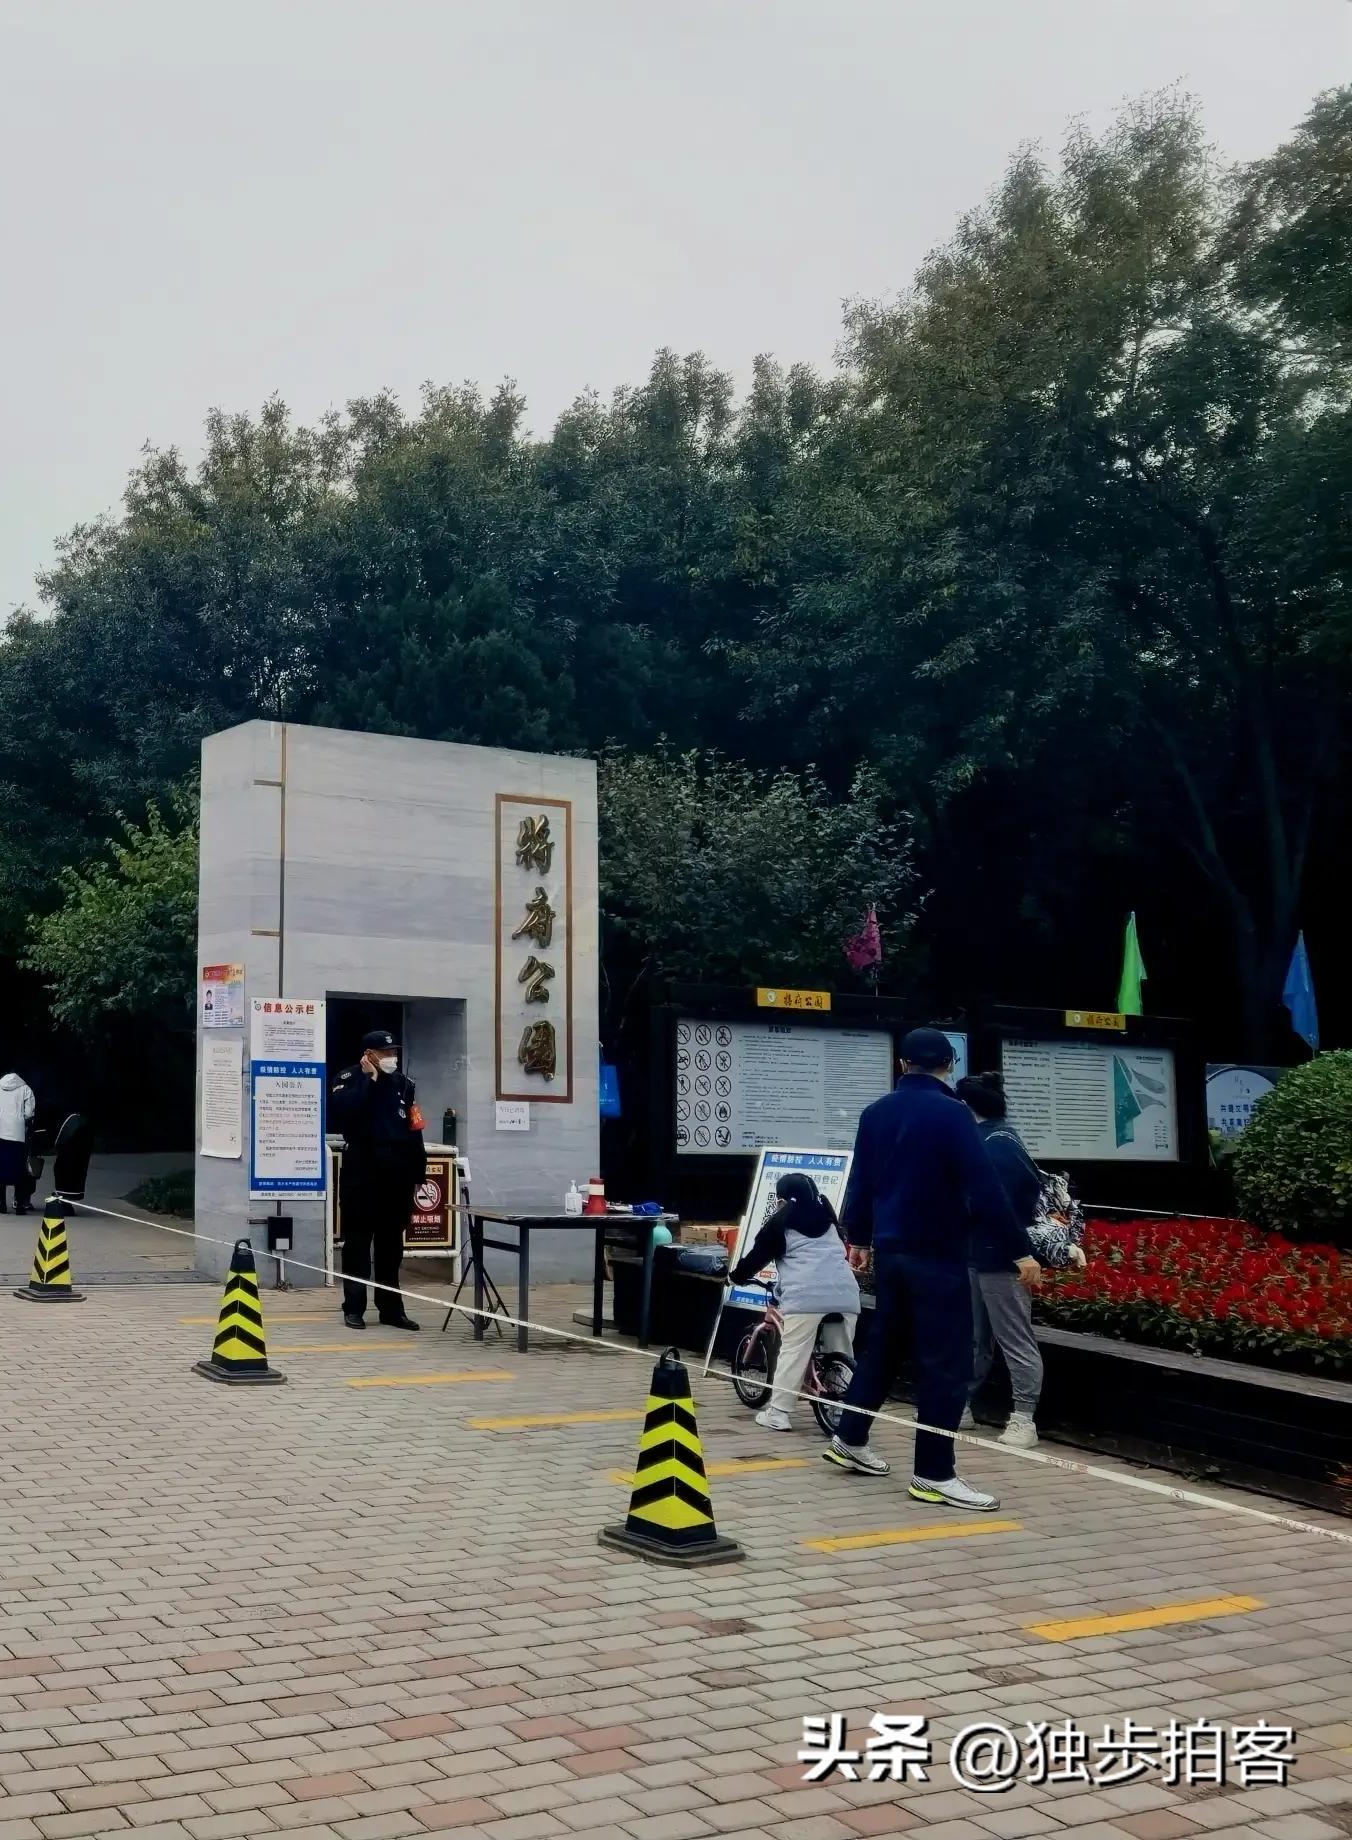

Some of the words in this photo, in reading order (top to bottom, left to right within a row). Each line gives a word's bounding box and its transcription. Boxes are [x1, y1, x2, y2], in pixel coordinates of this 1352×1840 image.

[263, 1002, 315, 1015] 信息公示栏
[770, 1154, 803, 1165] 疫情防控
[808, 1156, 842, 1167] 人人有责
[412, 1214, 441, 1224] 禁止吸烟
